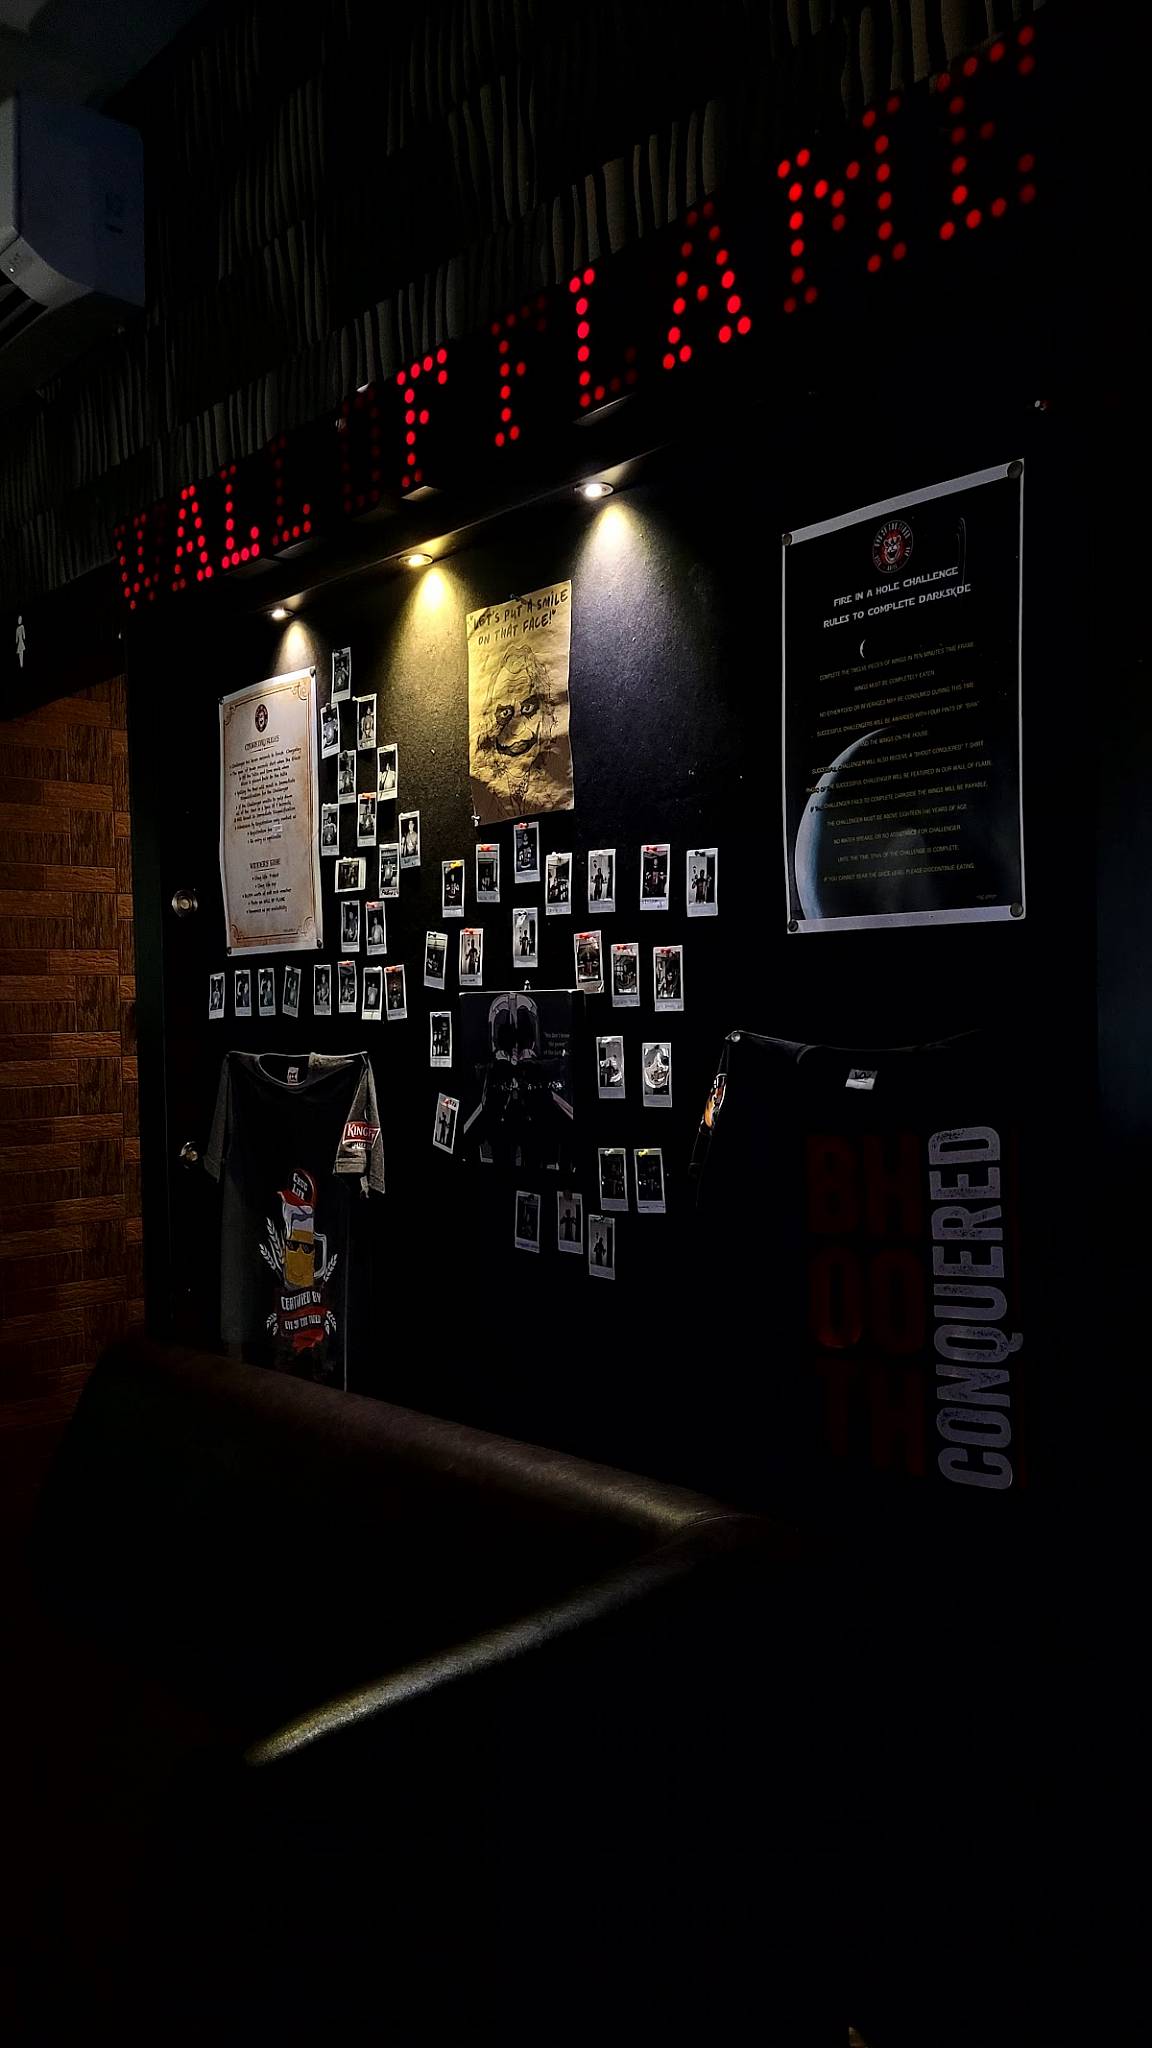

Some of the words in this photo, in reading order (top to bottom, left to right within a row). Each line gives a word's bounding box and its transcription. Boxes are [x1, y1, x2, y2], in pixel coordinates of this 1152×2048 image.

[114, 434, 314, 611] WALL
[336, 347, 450, 518] OF
[489, 25, 1037, 449] FLAME
[833, 594, 853, 608] FIRE
[855, 591, 864, 601] IN
[866, 589, 873, 598] A
[875, 581, 900, 596] HOLE
[903, 566, 960, 588] CHALLENGE
[504, 604, 523, 622] PUT
[527, 599, 533, 613] A
[537, 588, 568, 610] SMILE
[823, 614, 850, 629] RULES
[853, 610, 865, 620] TO
[868, 597, 916, 617] COMPLETE
[478, 634, 491, 646] ON
[494, 623, 518, 642] THAT
[280, 1291, 311, 1311] CERTIFIED
[927, 1125, 1024, 1491] CONQUERED
